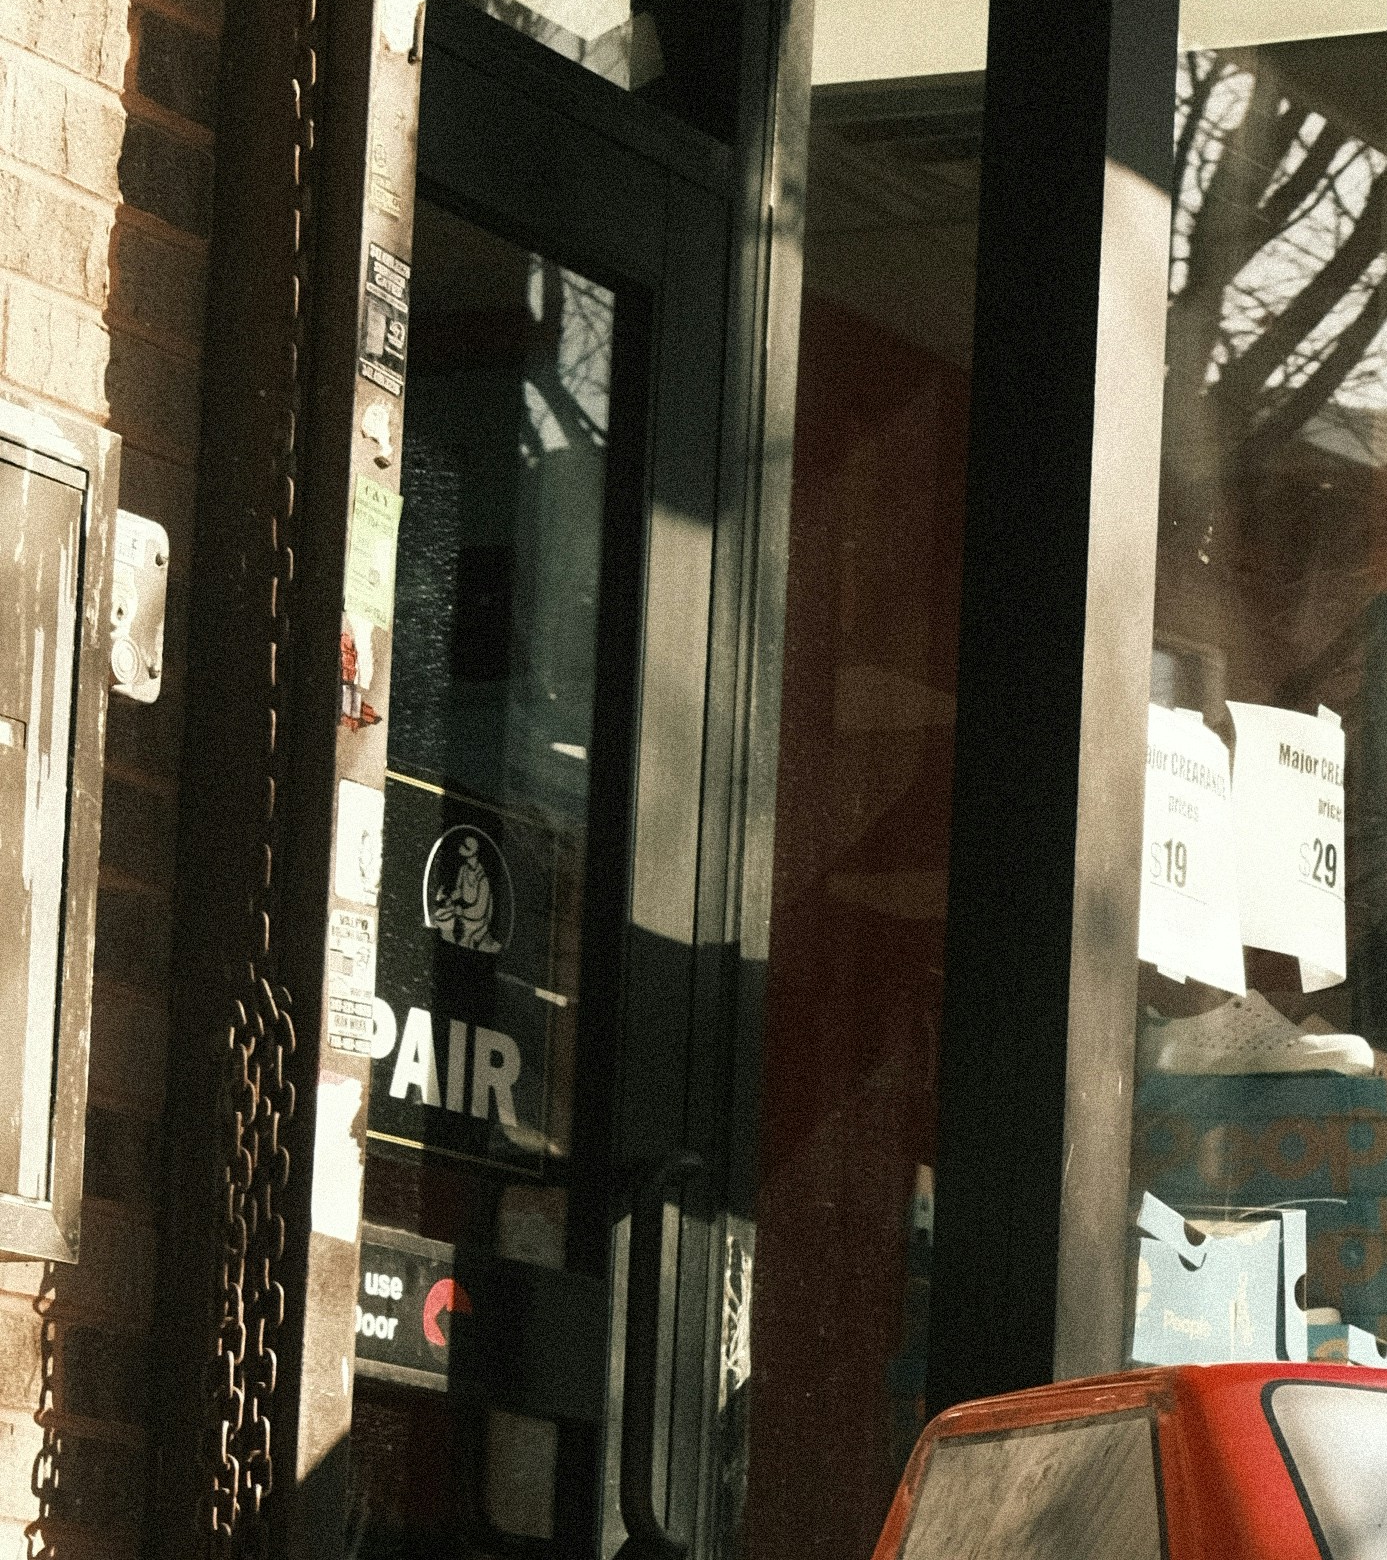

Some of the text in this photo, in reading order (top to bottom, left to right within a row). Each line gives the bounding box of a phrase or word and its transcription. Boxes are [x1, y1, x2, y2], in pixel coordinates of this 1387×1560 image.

[1146, 744, 1169, 772] ajor
[1278, 741, 1320, 775] Major
[364, 1271, 404, 1300] use
